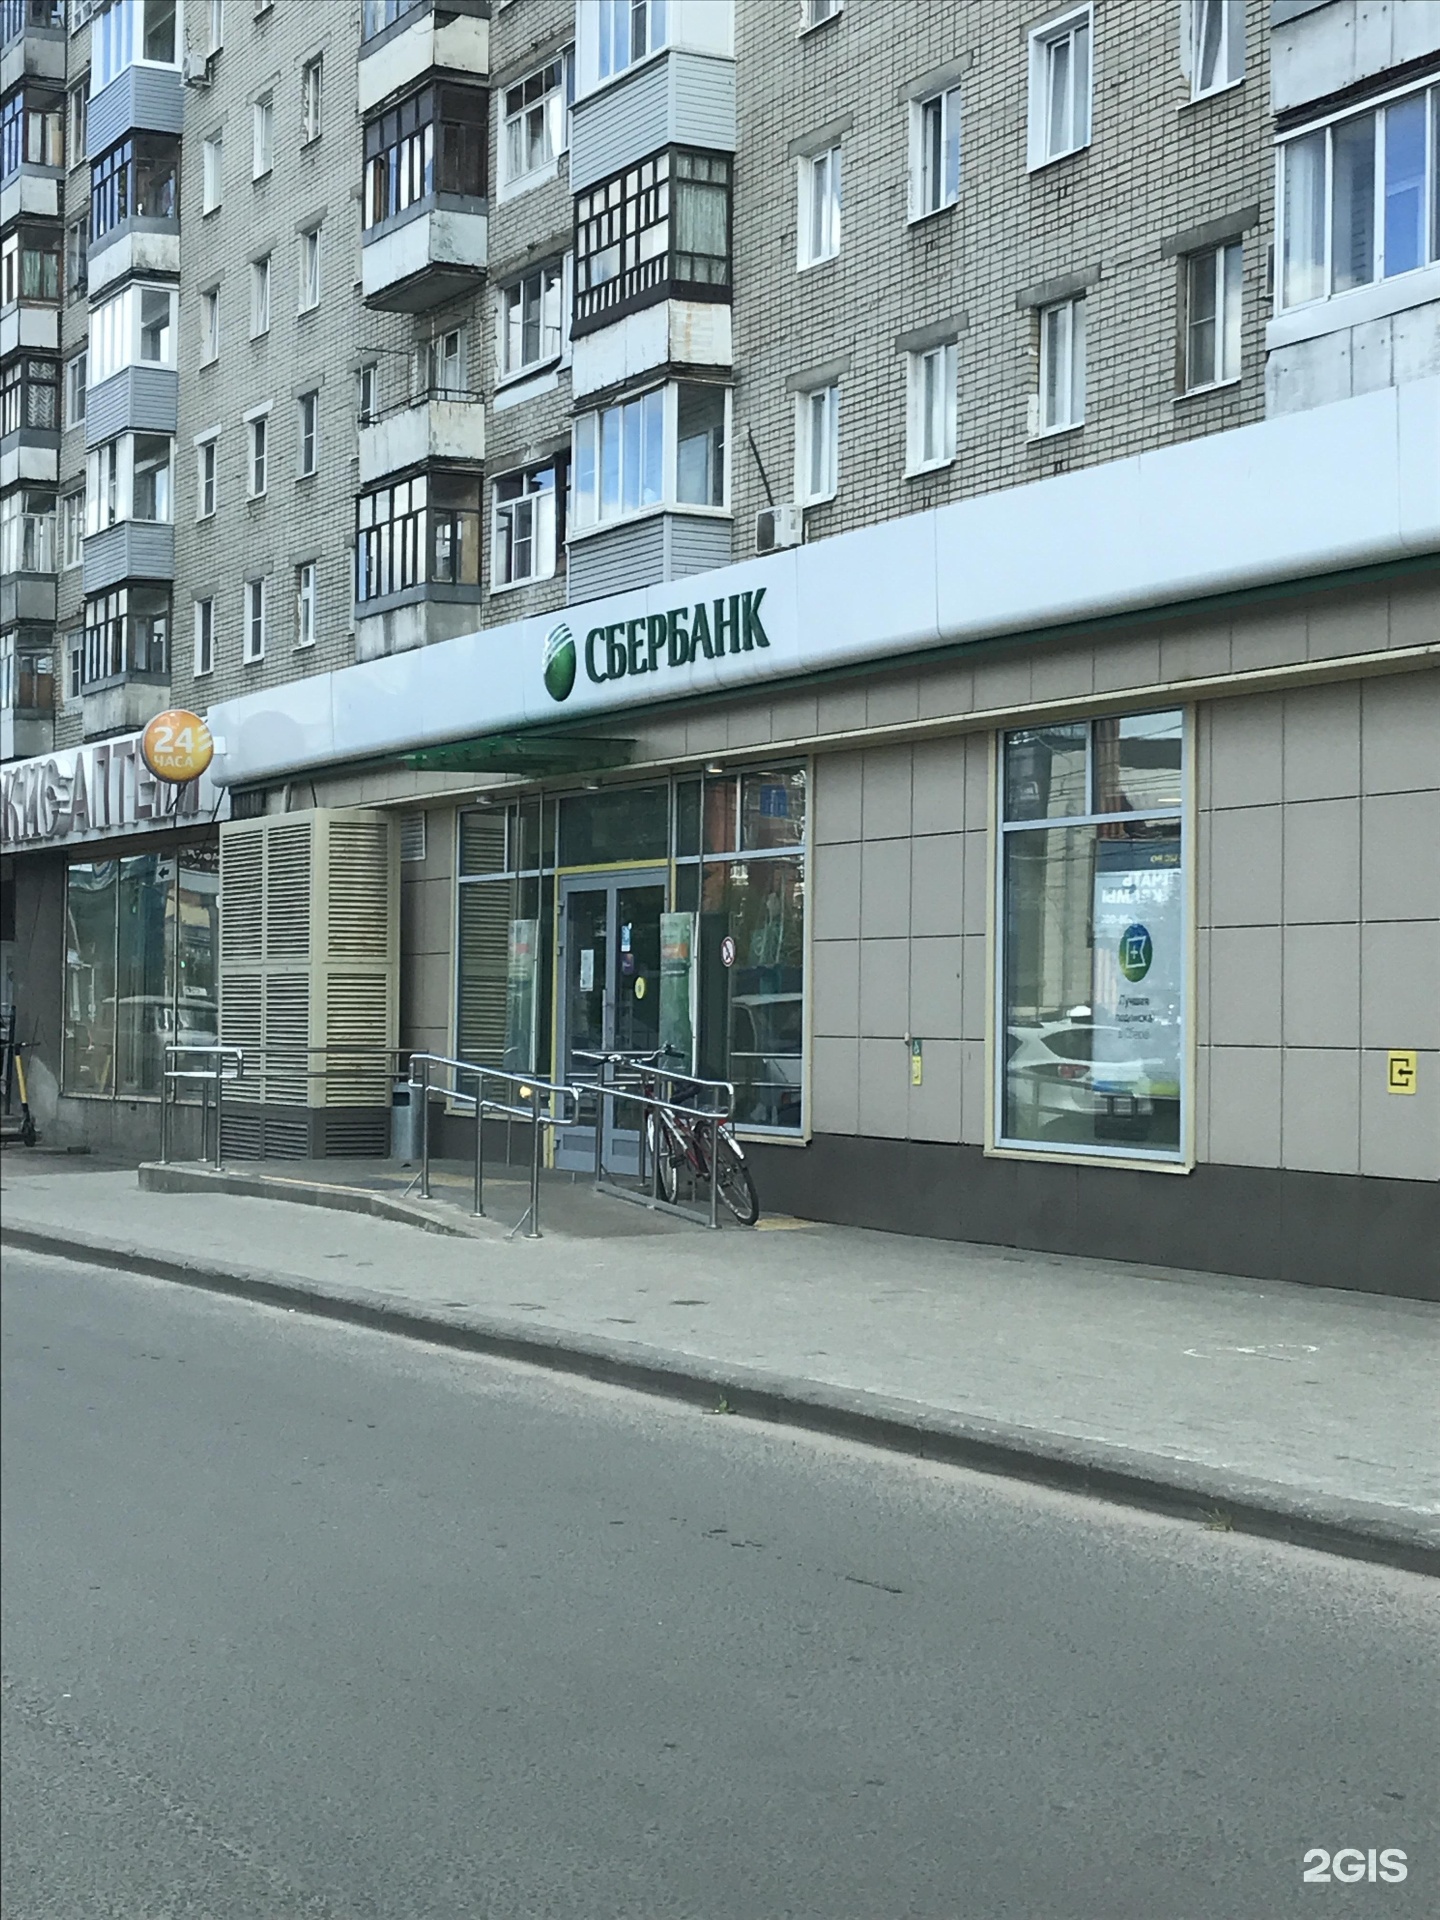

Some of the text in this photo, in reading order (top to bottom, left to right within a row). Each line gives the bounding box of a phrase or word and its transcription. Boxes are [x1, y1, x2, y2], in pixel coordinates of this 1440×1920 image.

[585, 588, 770, 684] СБЕРБАНК
[153, 726, 194, 754] 24
[153, 753, 194, 768] ЧАСА
